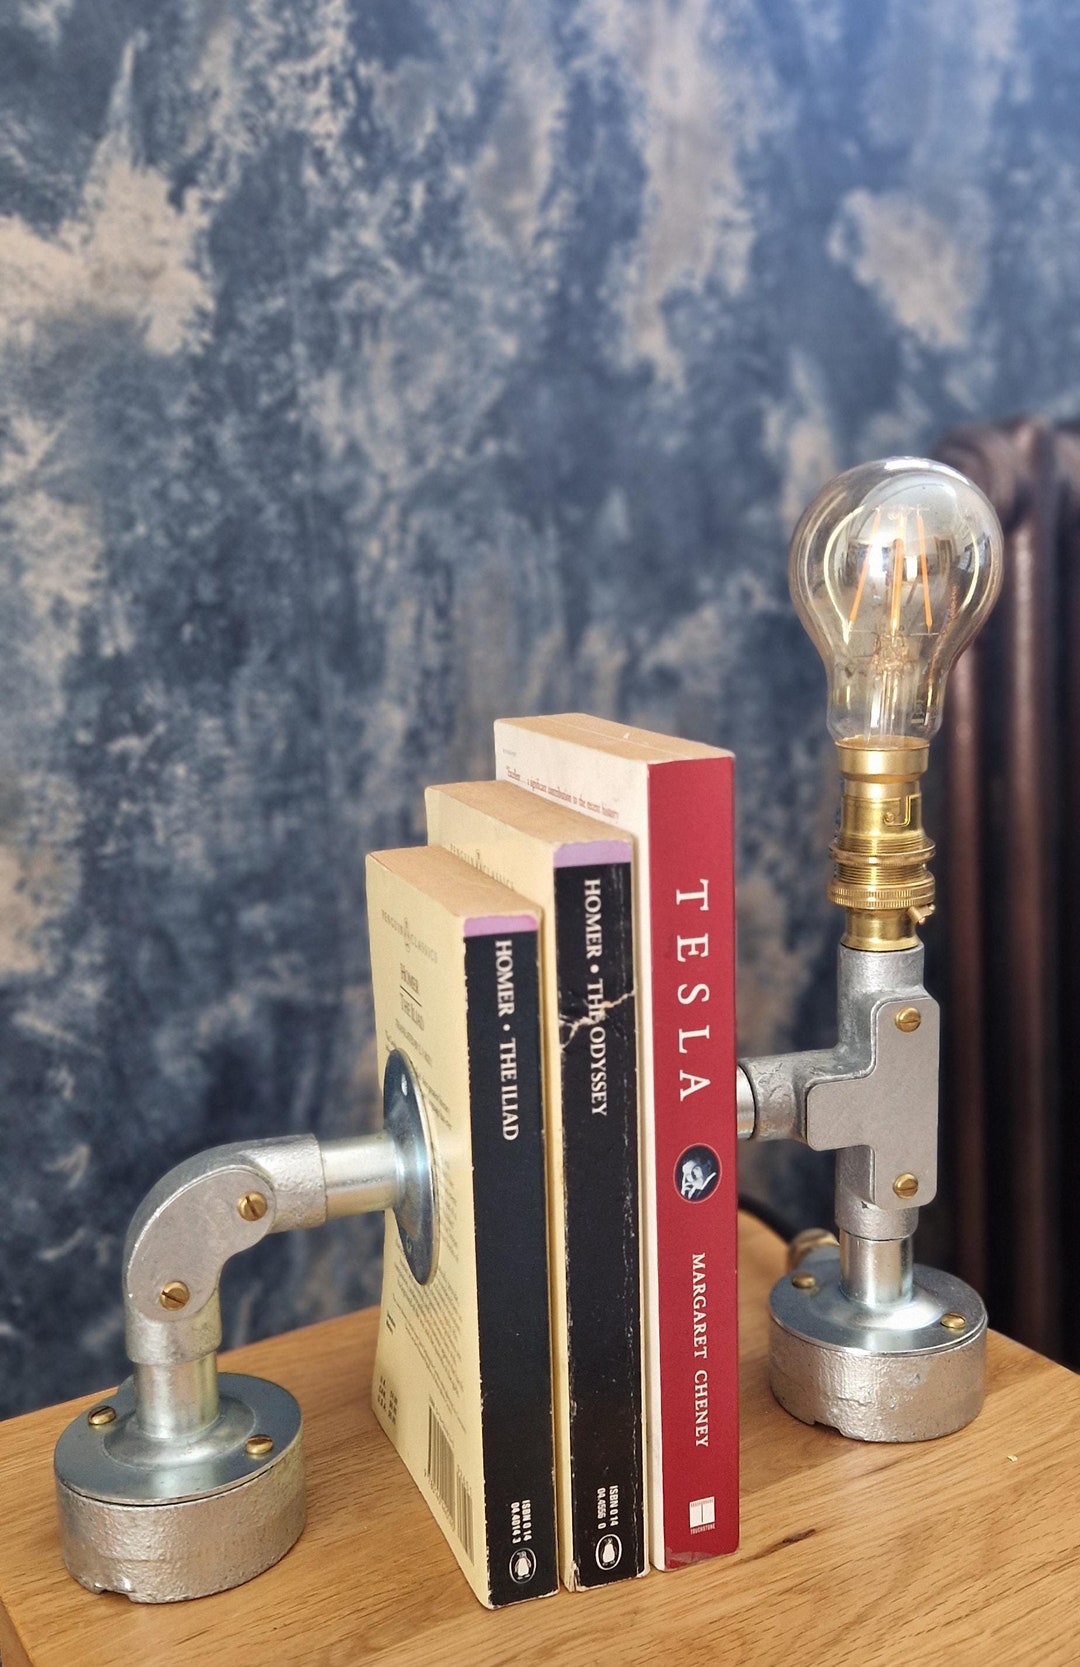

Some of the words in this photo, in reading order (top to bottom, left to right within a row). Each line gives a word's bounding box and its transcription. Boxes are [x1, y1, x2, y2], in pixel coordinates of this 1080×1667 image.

[584, 879, 603, 960] HOMER
[495, 940, 515, 1017] HOMER
[676, 879, 711, 1102] TESLA
[499, 1038, 518, 1082] THE
[589, 1027, 607, 1117] ODYSSEY
[501, 1084, 520, 1141] ILIAD
[692, 1252, 707, 1359] MARGARET
[694, 1369, 709, 1447] CHENEY
[521, 1499, 531, 1522] ISBN
[609, 1485, 619, 1508] ISBN
[512, 1536, 522, 1544] 3
